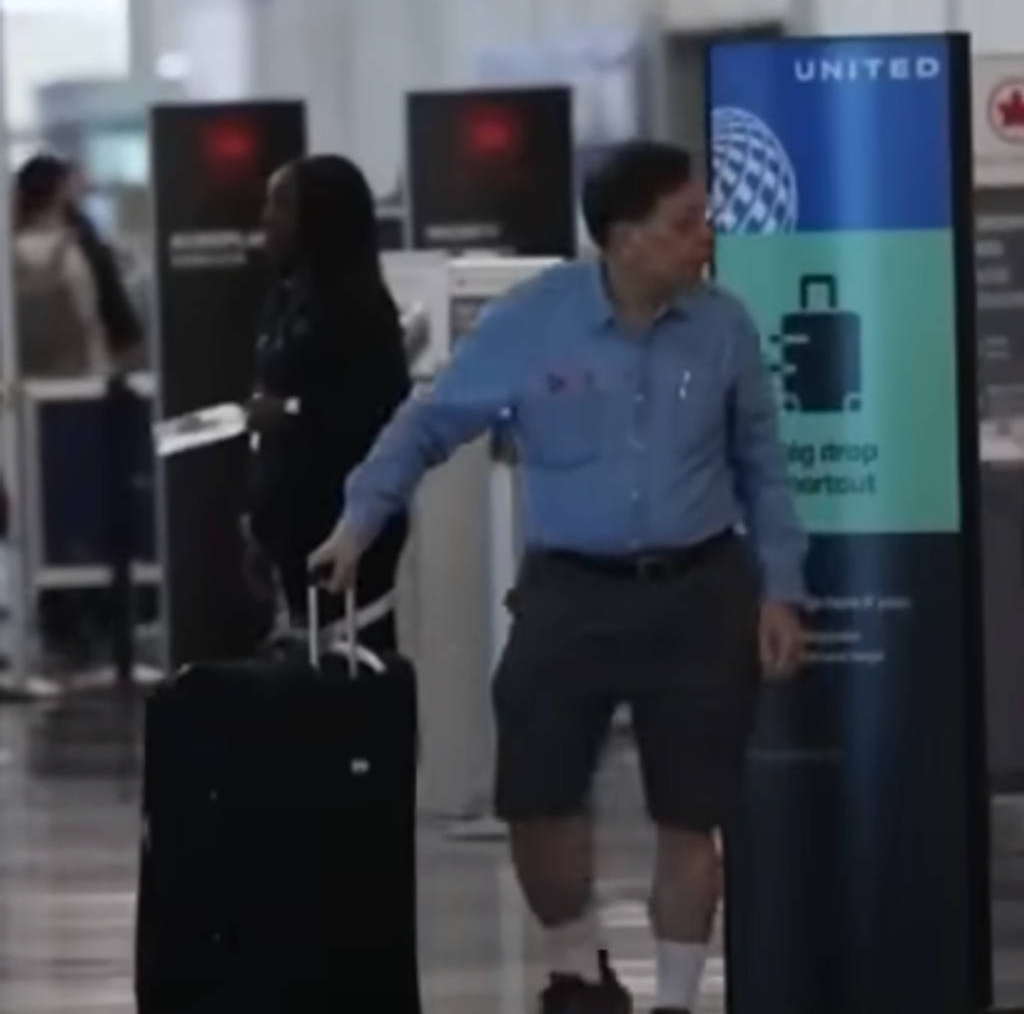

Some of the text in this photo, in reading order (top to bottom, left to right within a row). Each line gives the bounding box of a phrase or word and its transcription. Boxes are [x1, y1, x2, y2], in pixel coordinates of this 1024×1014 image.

[794, 56, 941, 82] UNITED
[785, 439, 879, 468] ag drop
